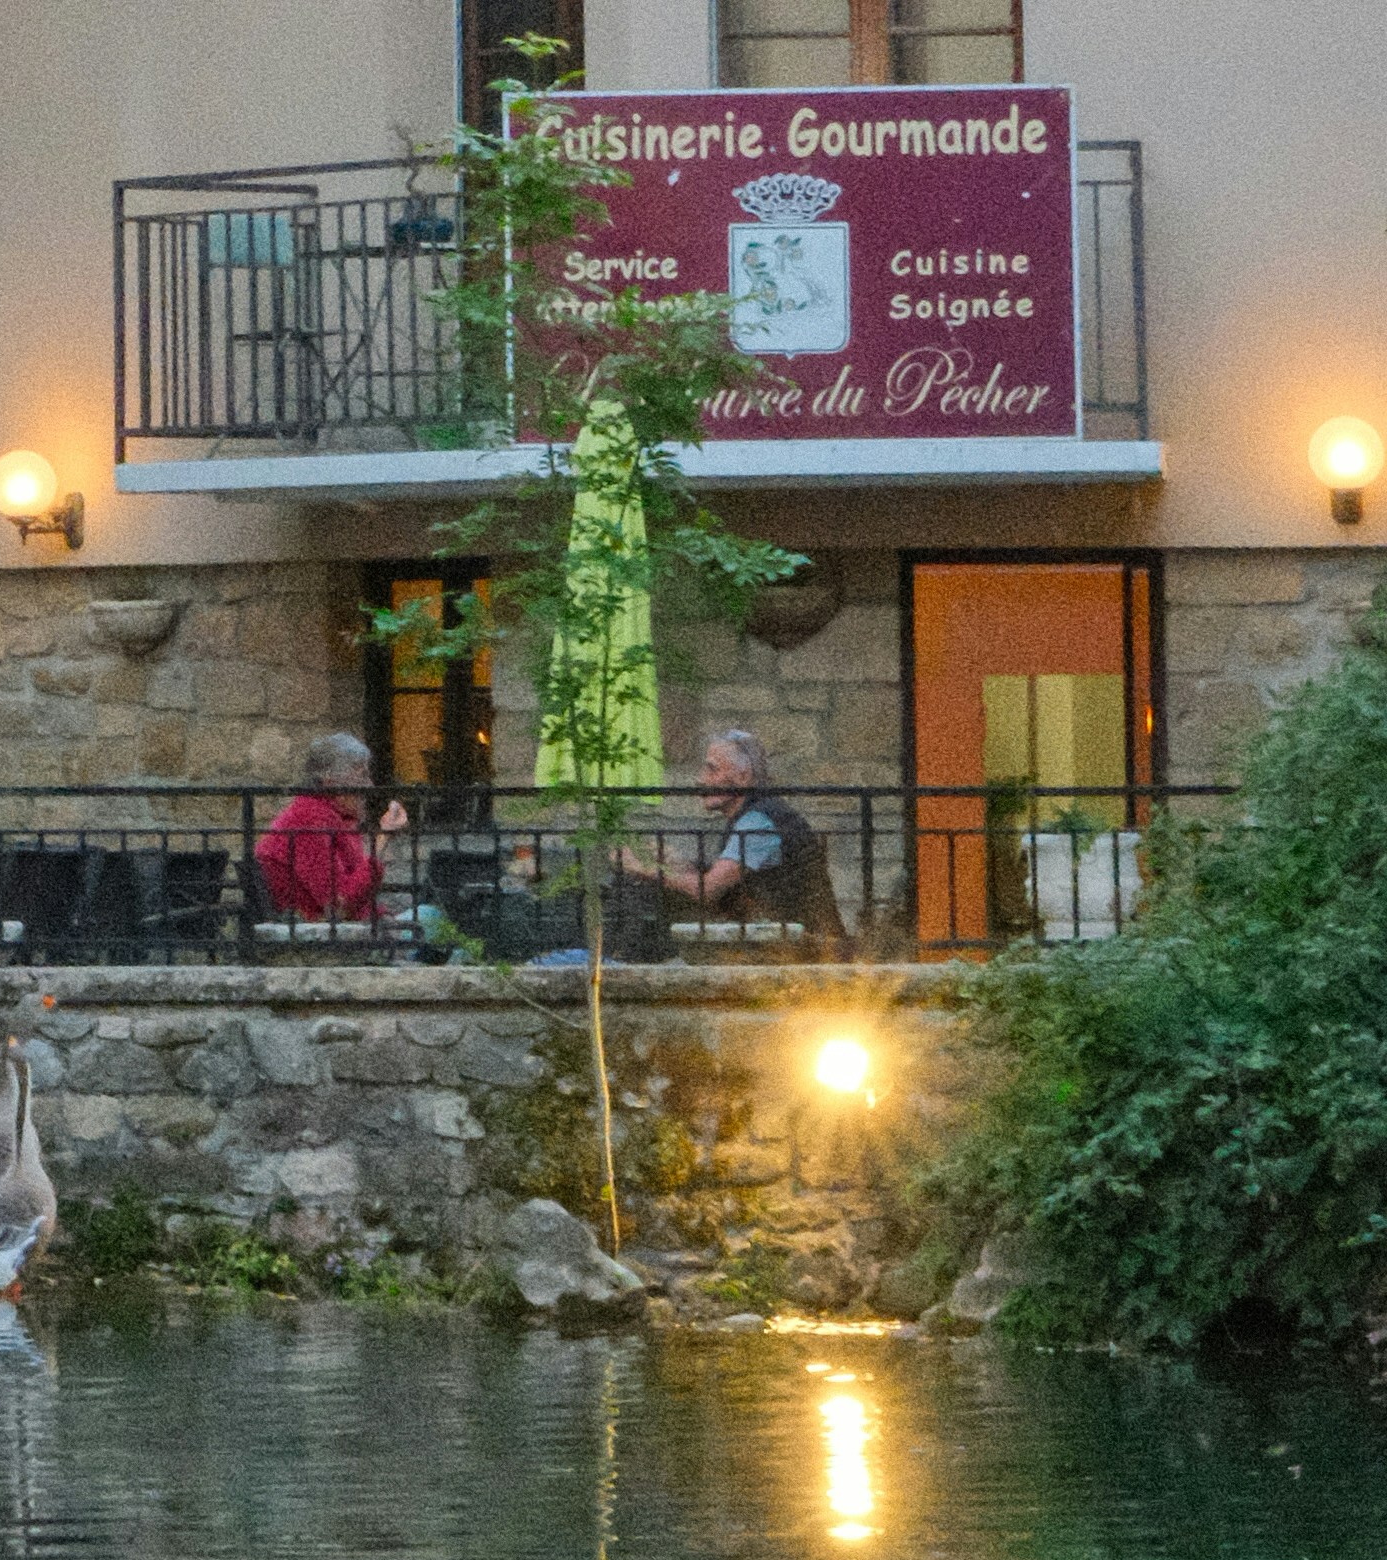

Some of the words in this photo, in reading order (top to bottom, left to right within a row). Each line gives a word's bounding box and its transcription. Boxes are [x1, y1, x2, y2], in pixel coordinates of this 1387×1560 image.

[786, 103, 1047, 158] Gourmande
[563, 249, 678, 281] Service
[890, 248, 1029, 277] Cuisine
[888, 288, 1034, 327] Soignée
[812, 364, 866, 417] du
